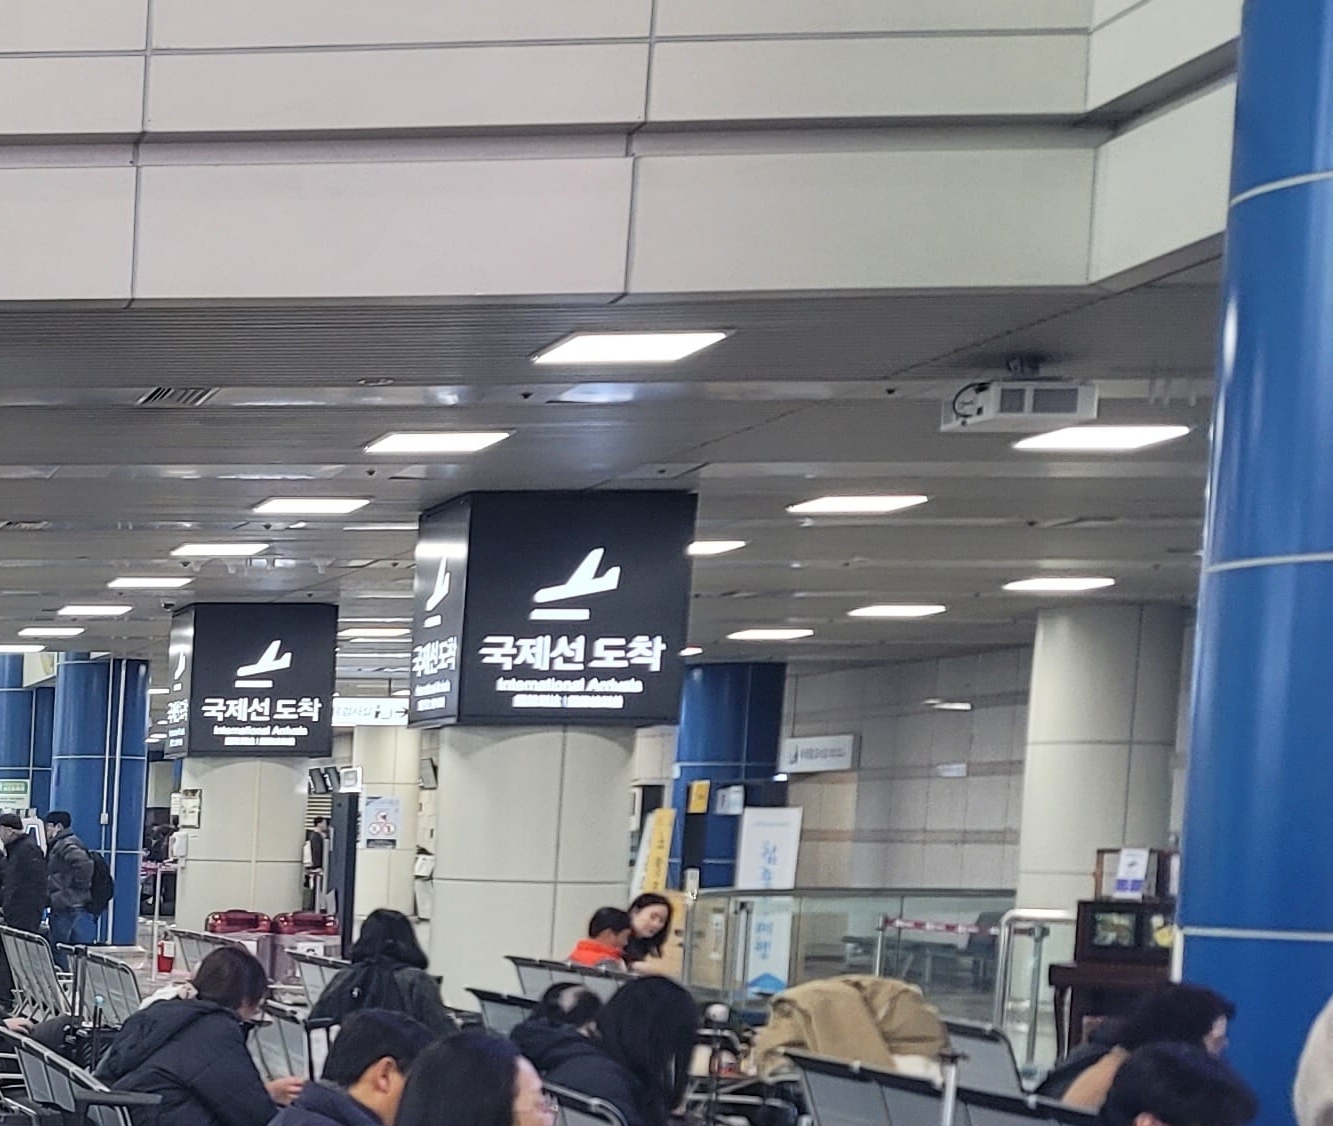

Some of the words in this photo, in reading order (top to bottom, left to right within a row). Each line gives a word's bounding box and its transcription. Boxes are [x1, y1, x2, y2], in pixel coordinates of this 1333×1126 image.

[479, 634, 586, 671] 국제선
[588, 634, 667, 672] 도착
[496, 676, 586, 692] International
[201, 697, 270, 722] 국제선
[272, 697, 323, 722] 도착
